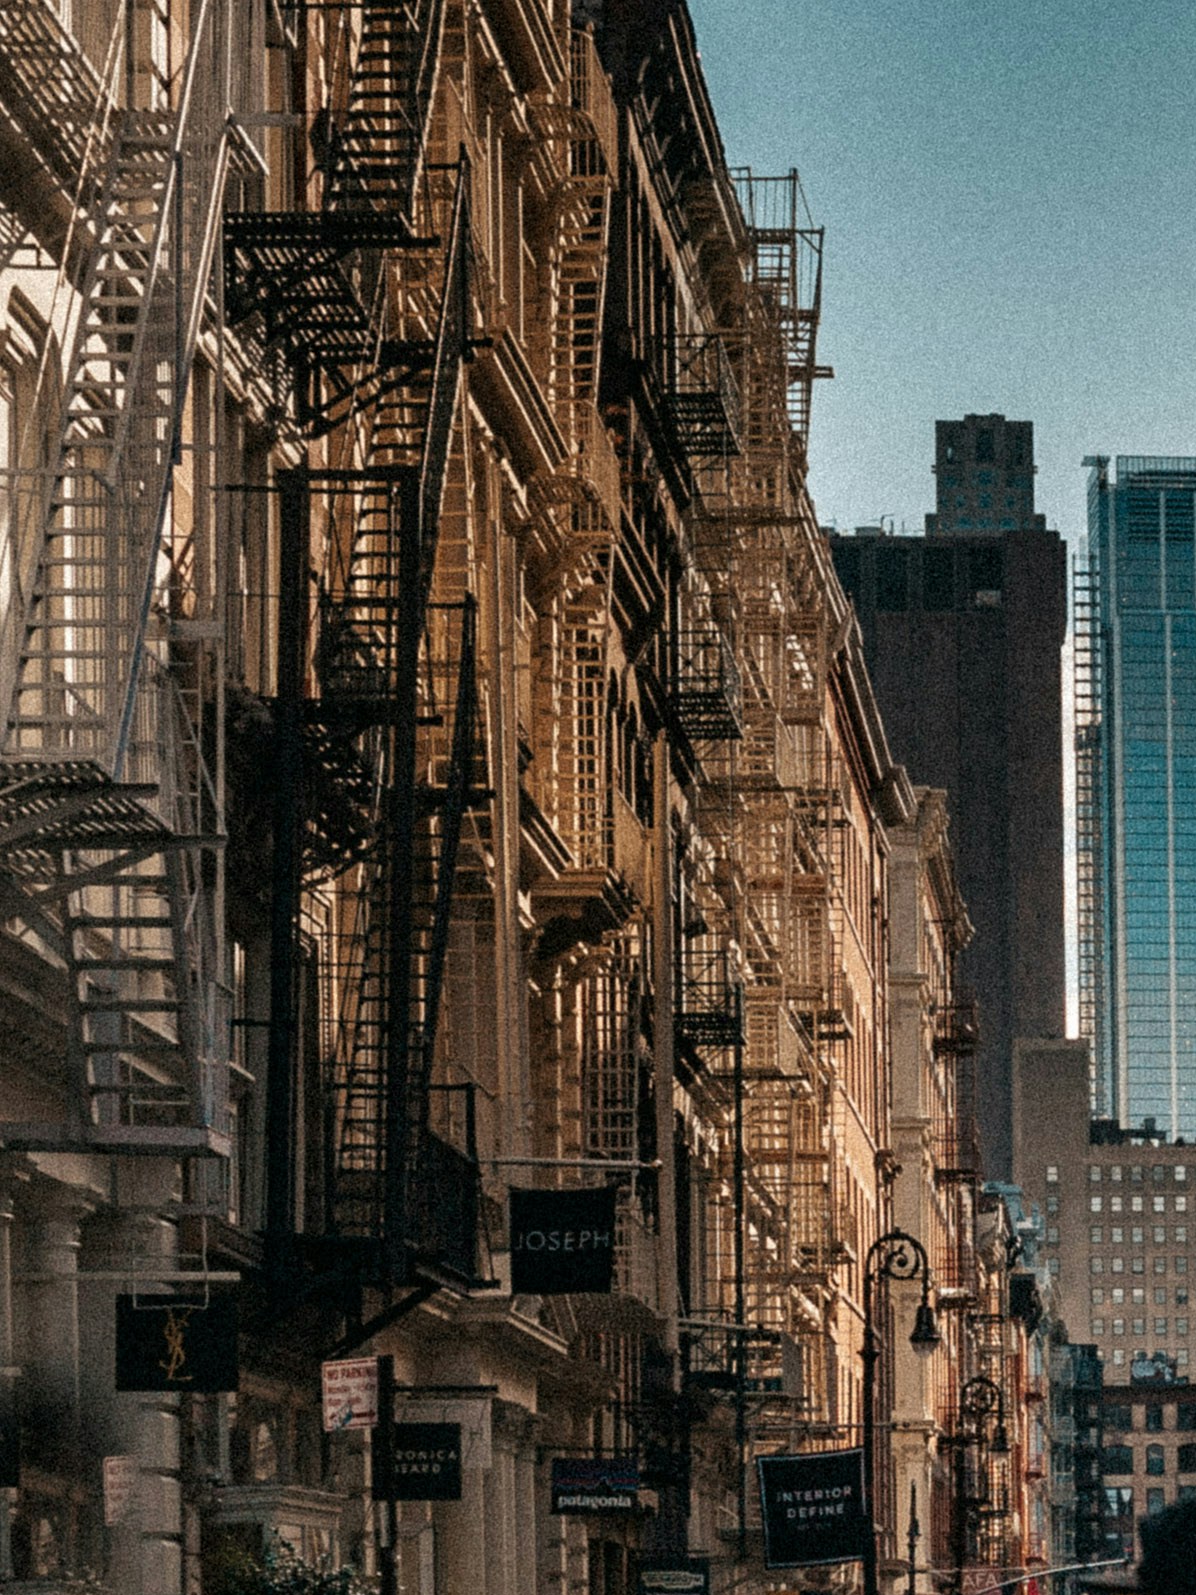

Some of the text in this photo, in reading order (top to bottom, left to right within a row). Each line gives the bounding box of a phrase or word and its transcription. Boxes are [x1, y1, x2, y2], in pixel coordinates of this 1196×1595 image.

[514, 1230, 611, 1252] JOSEPH
[395, 1449, 458, 1461] RONICA
[557, 1494, 632, 1510] patagonia
[776, 1485, 853, 1503] INTERIOR
[786, 1502, 845, 1519] DEFINE
